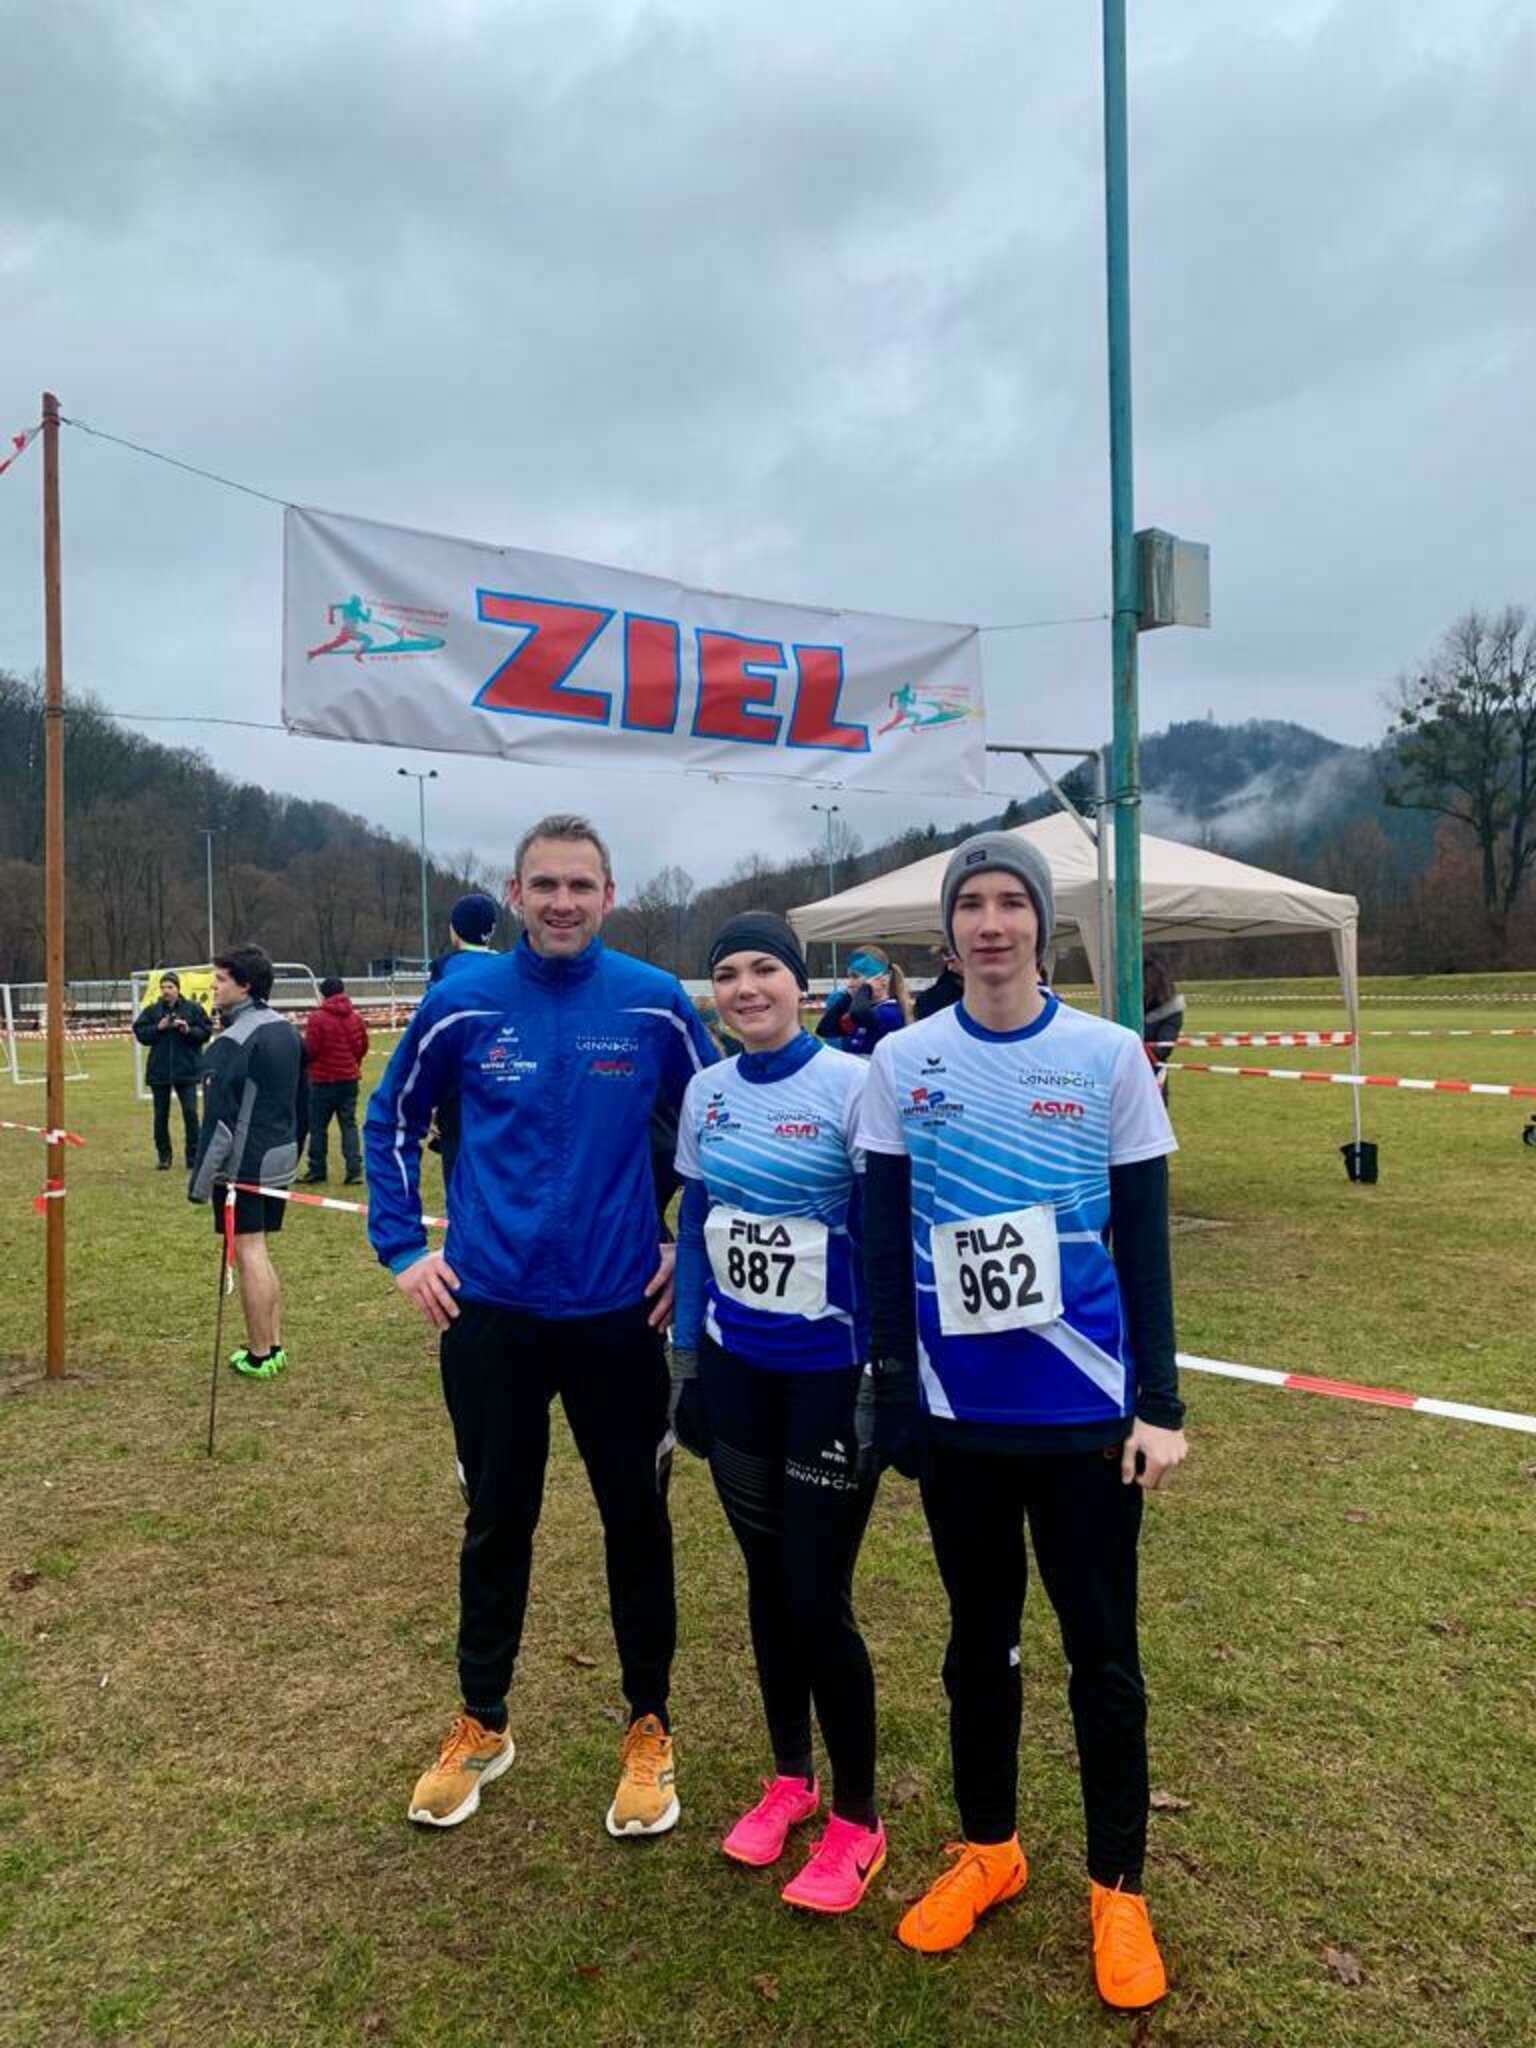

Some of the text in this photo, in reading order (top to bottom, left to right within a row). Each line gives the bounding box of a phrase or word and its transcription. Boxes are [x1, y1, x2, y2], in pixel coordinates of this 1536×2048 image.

[470, 588, 870, 754] ZIEL
[729, 1218, 792, 1247] FILA
[954, 1221, 1024, 1257] FILA
[727, 1246, 796, 1297] 887
[959, 1253, 1044, 1315] 962
